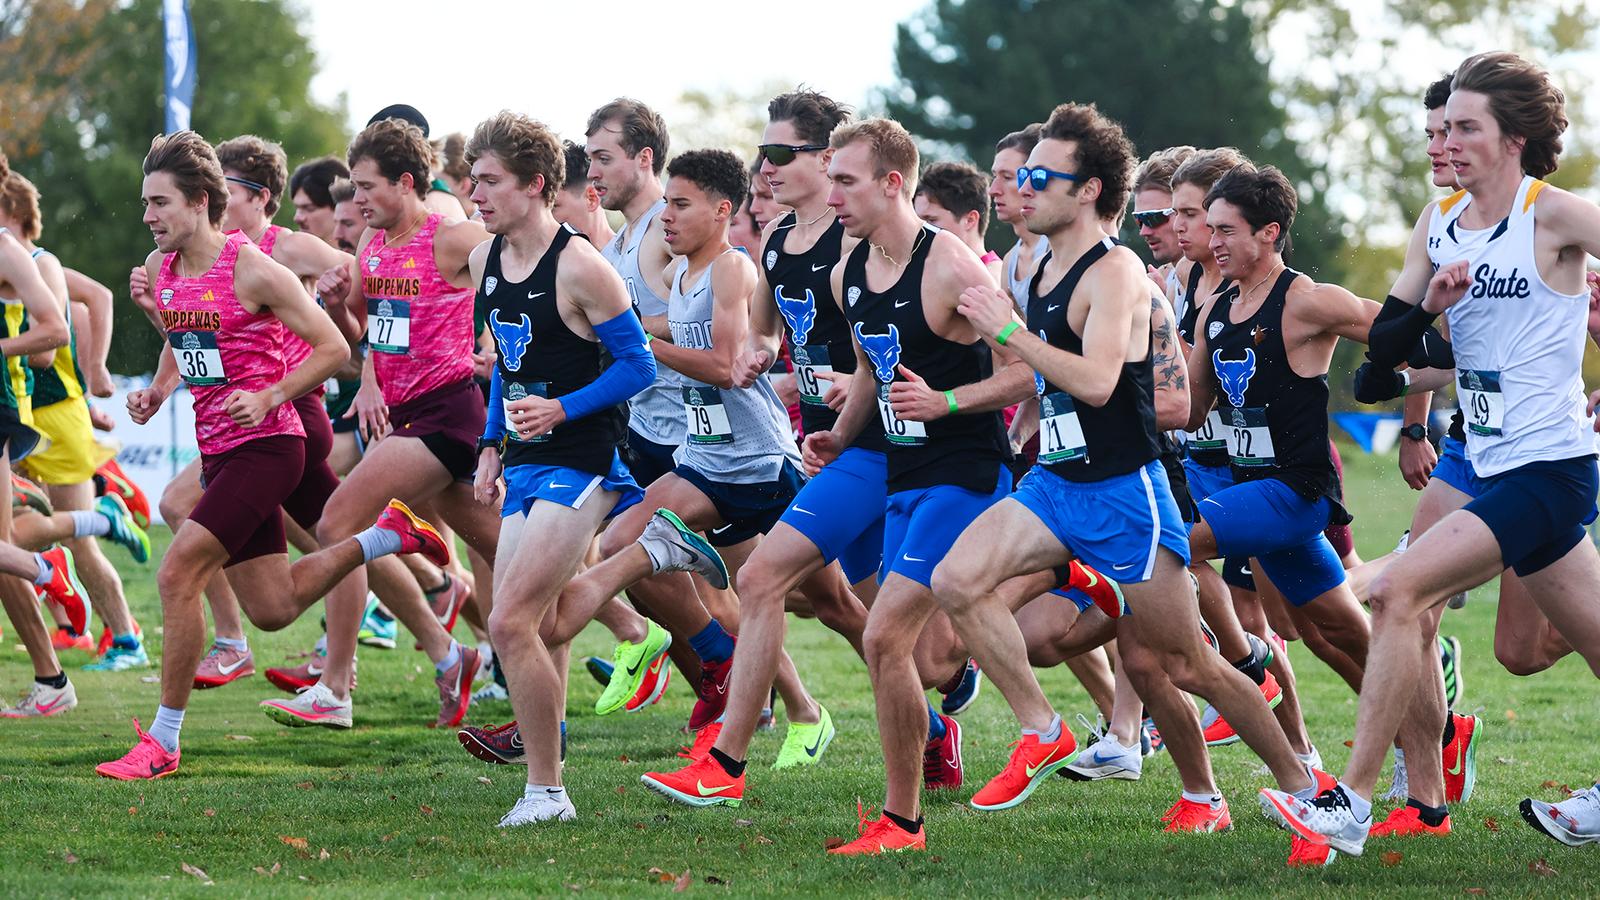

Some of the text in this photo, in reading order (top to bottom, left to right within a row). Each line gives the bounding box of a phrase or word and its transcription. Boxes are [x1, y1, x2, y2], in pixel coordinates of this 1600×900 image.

[365, 276, 420, 296] HIPPEWAS
[1471, 263, 1530, 299] State
[160, 310, 221, 330] HIPPEWAS
[377, 318, 394, 345] 27
[183, 351, 208, 377] 36
[799, 366, 820, 396] 19
[691, 407, 713, 436] 79
[1046, 418, 1066, 452] 21
[1233, 428, 1256, 458] 22
